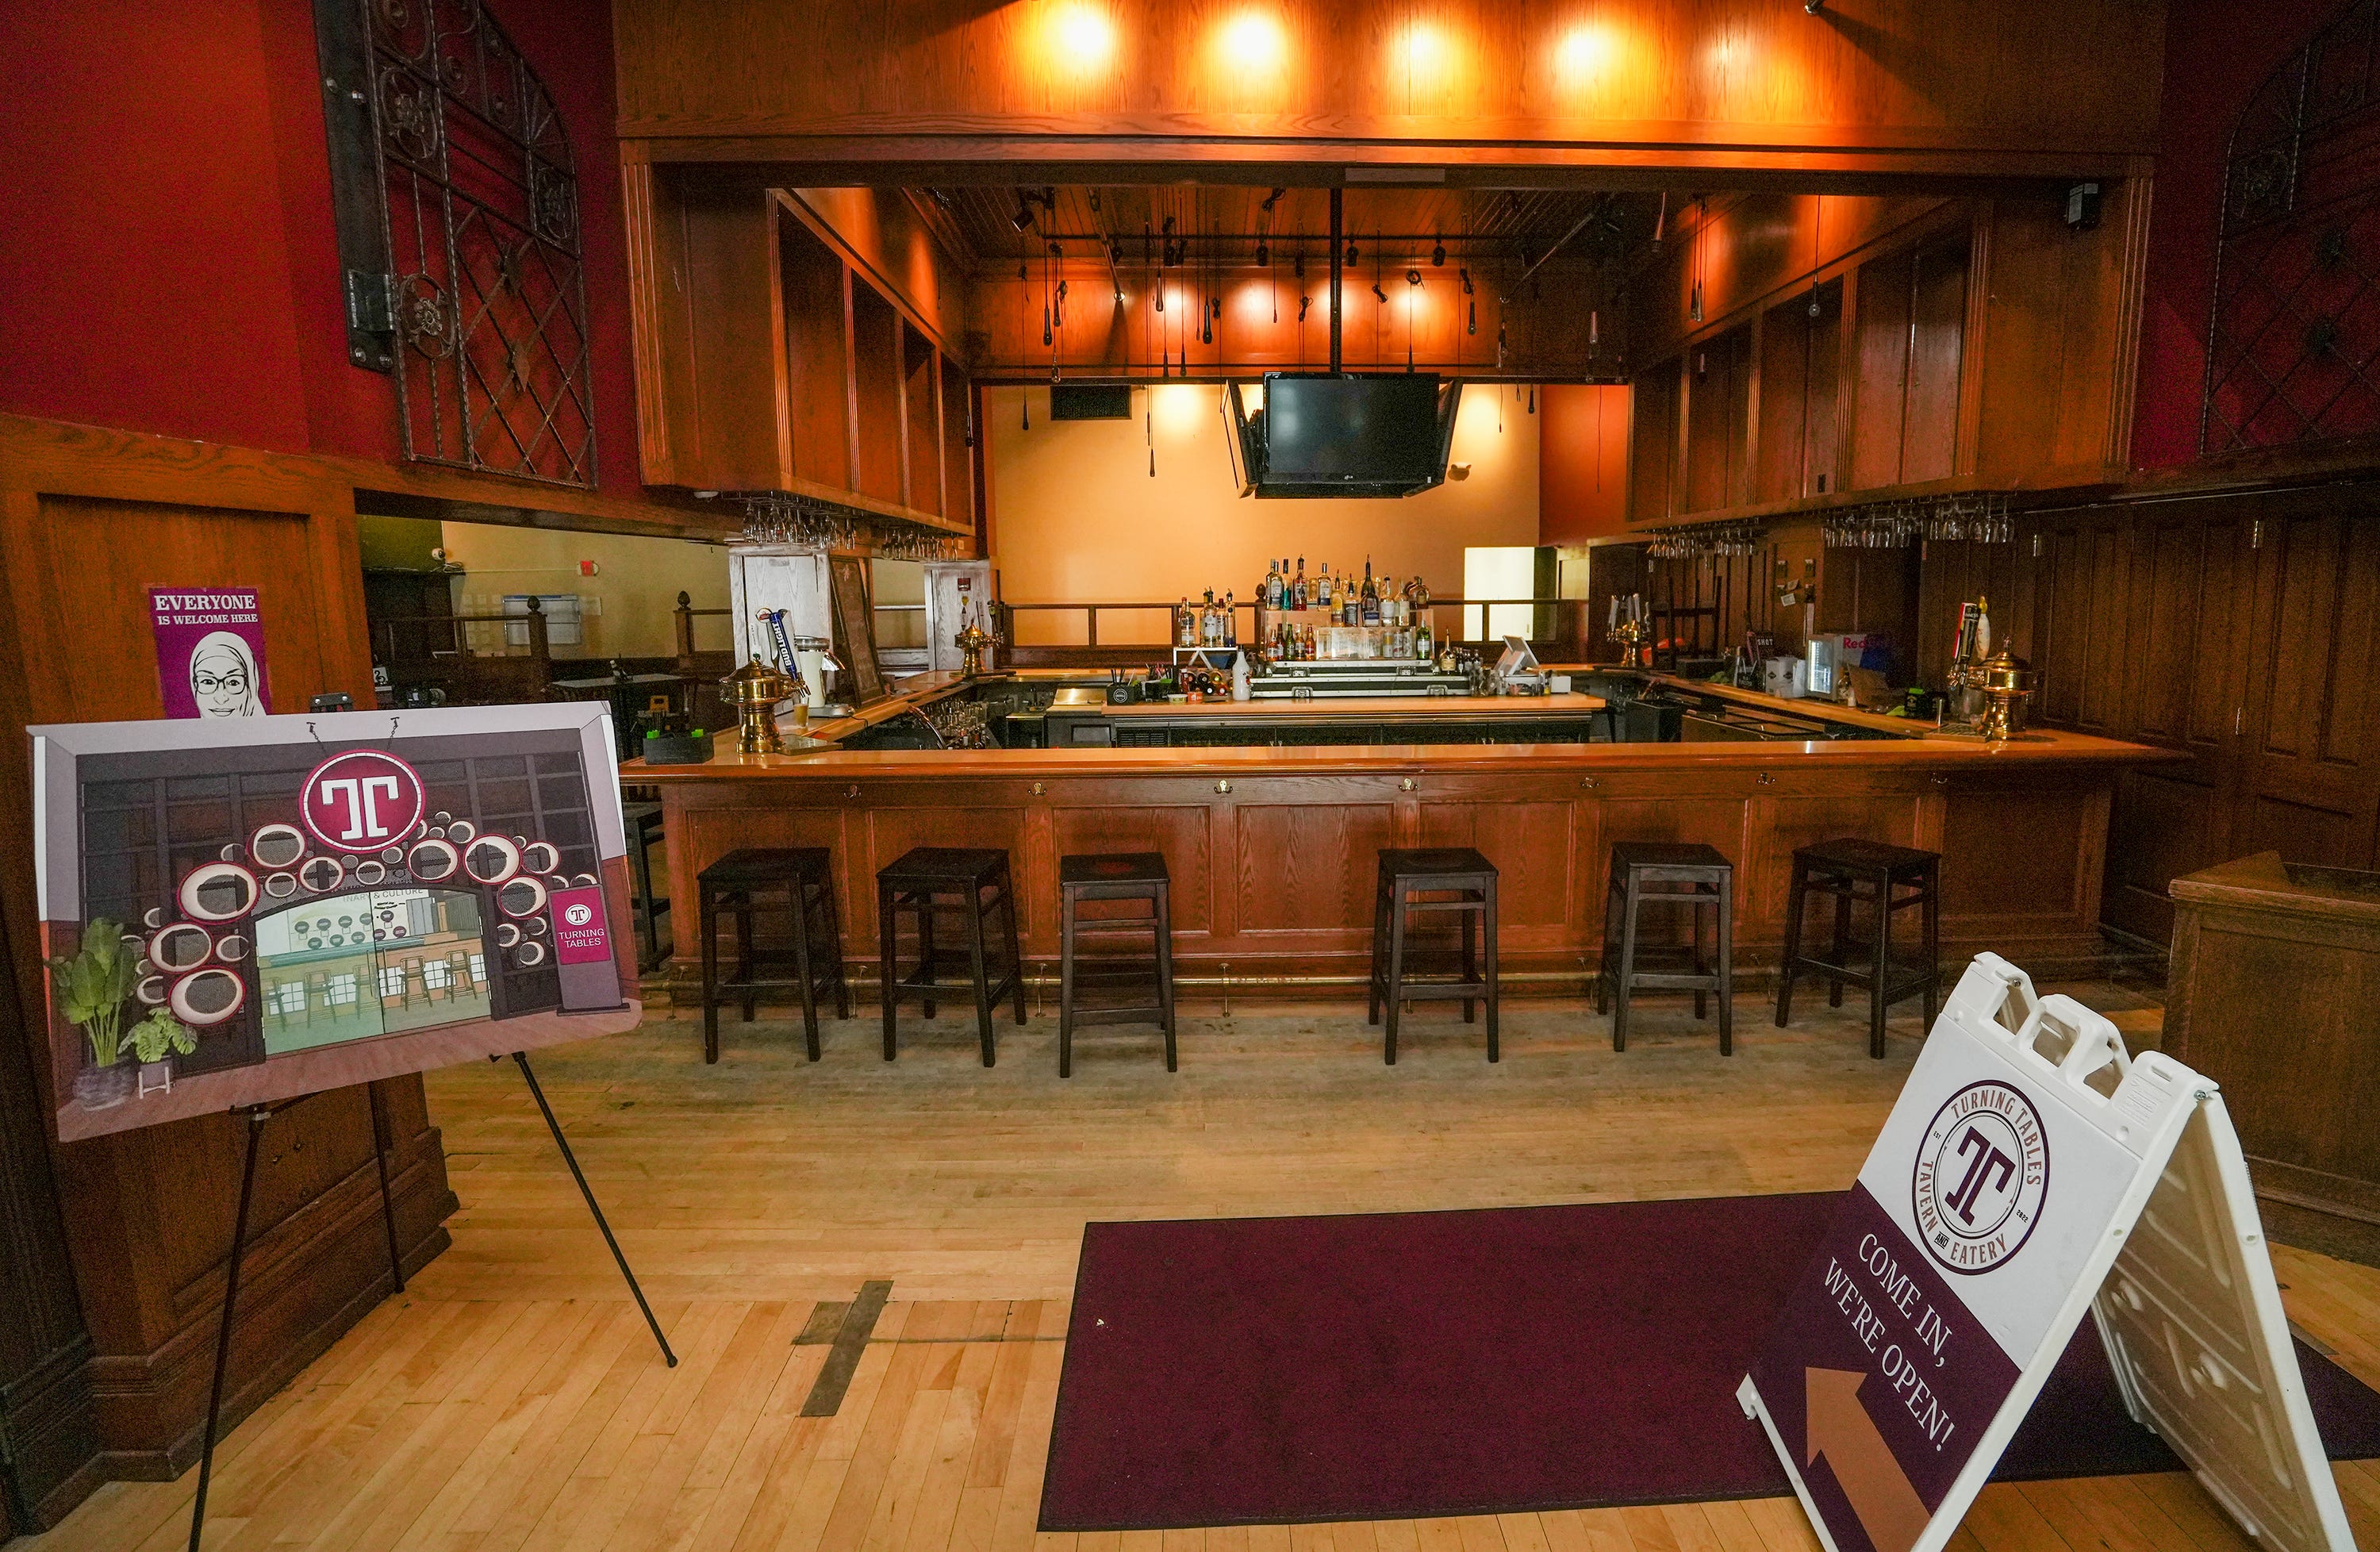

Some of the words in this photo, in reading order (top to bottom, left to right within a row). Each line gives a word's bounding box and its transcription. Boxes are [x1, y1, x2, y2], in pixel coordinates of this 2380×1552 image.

[154, 595, 256, 611] EVERYONE
[157, 616, 171, 625] IS
[173, 614, 228, 625] WELCOME
[231, 613, 258, 624] HERE
[772, 622, 786, 647] LIGHT
[1844, 637, 1866, 648] Red
[559, 928, 605, 940] TURNING
[564, 938, 601, 948] TABLES
[1951, 1089, 2016, 1119] TURNING
[2014, 1108, 2043, 1185] TABLES
[1919, 1161, 1938, 1233] TAVERN
[1933, 1231, 1950, 1249] AND
[1950, 1233, 2006, 1265] EATERY
[2016, 1209, 2029, 1224] 2022
[1859, 1234, 1921, 1320] COME
[1914, 1304, 1952, 1367] IN,
[1824, 1257, 1886, 1354] WE'RE
[1882, 1344, 1956, 1451] OPEN!
